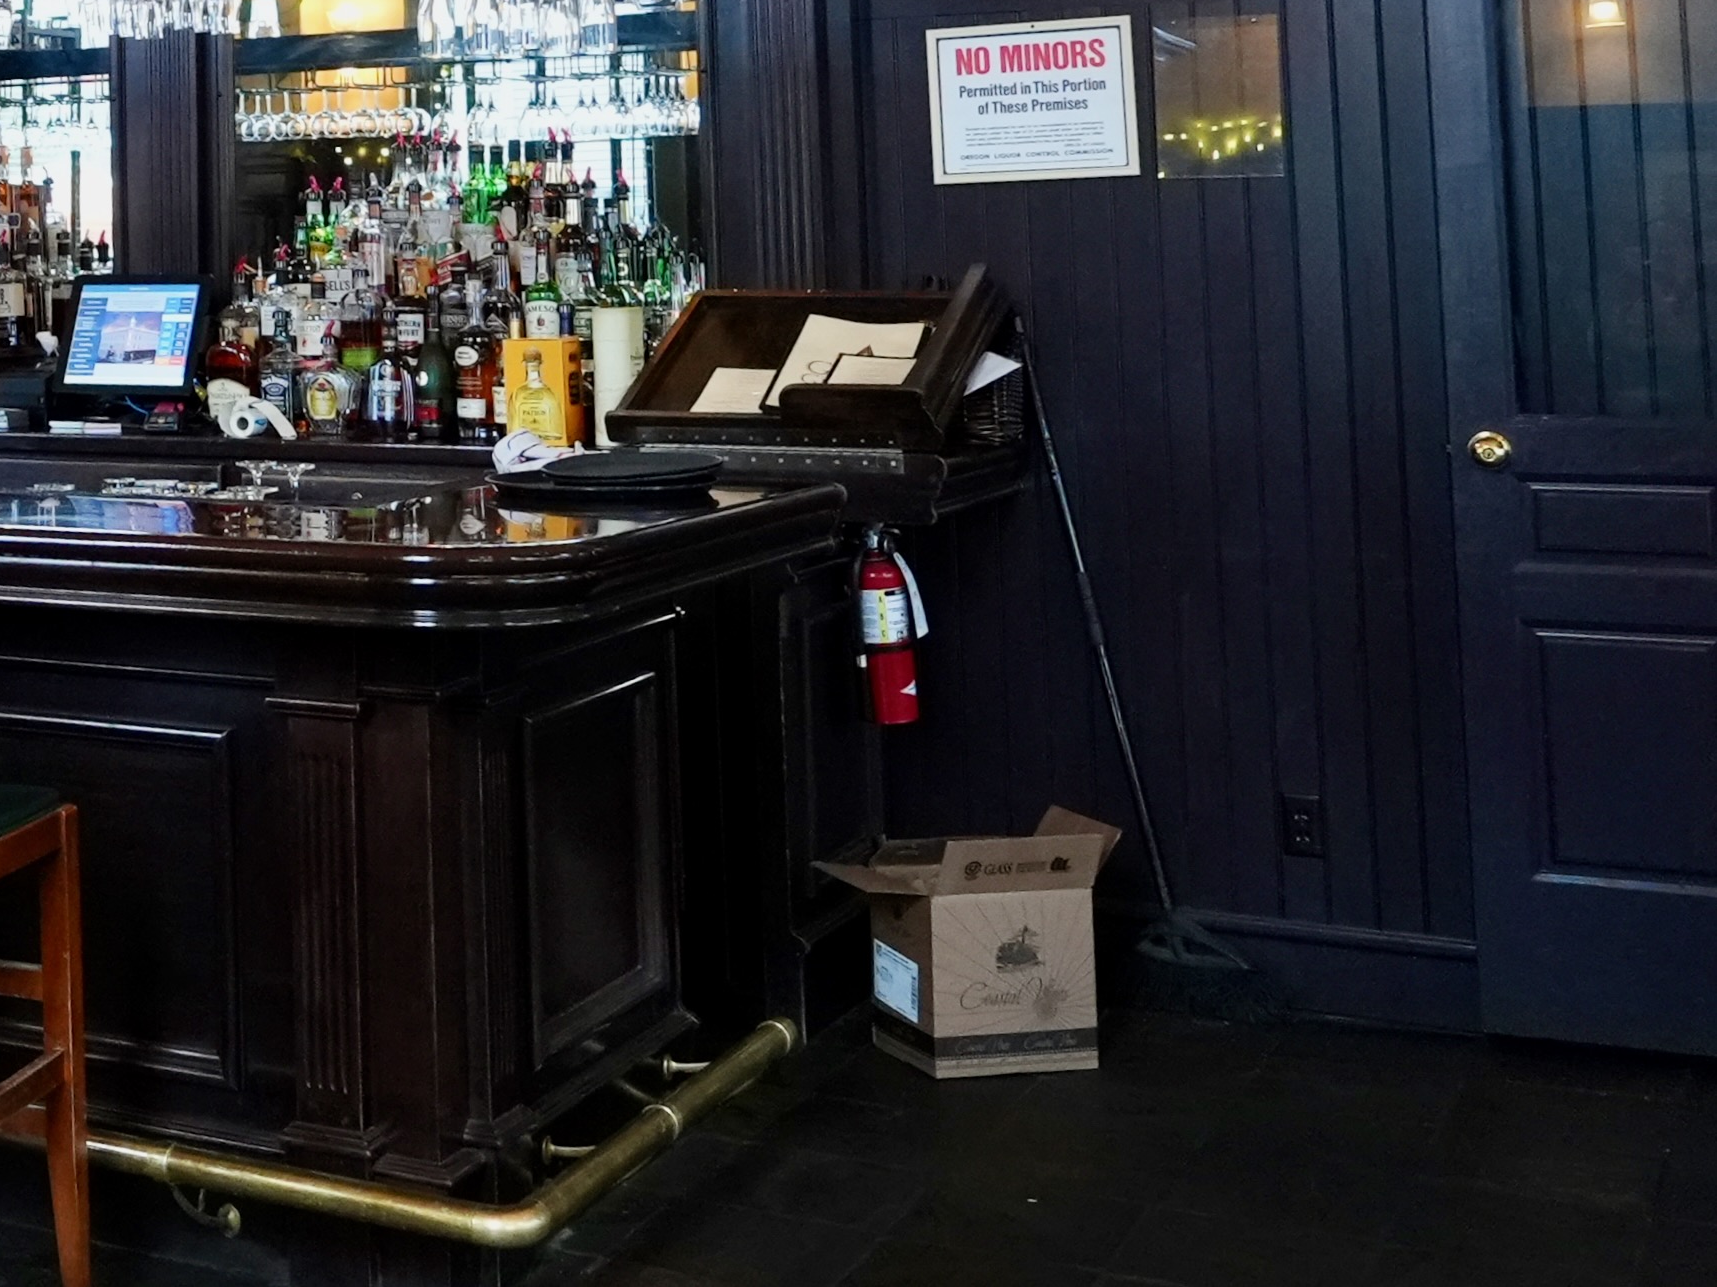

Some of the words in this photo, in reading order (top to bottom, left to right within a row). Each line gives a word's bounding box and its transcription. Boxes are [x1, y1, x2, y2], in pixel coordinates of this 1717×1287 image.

[955, 46, 991, 76] NO
[999, 38, 1107, 73] MINORS
[959, 81, 1018, 100] Permitted
[1020, 81, 1031, 96] in
[1033, 79, 1059, 96] This
[1062, 77, 1108, 94] Portion
[978, 101, 991, 116] of
[993, 99, 1029, 114] These
[1031, 97, 1090, 113] Premises
